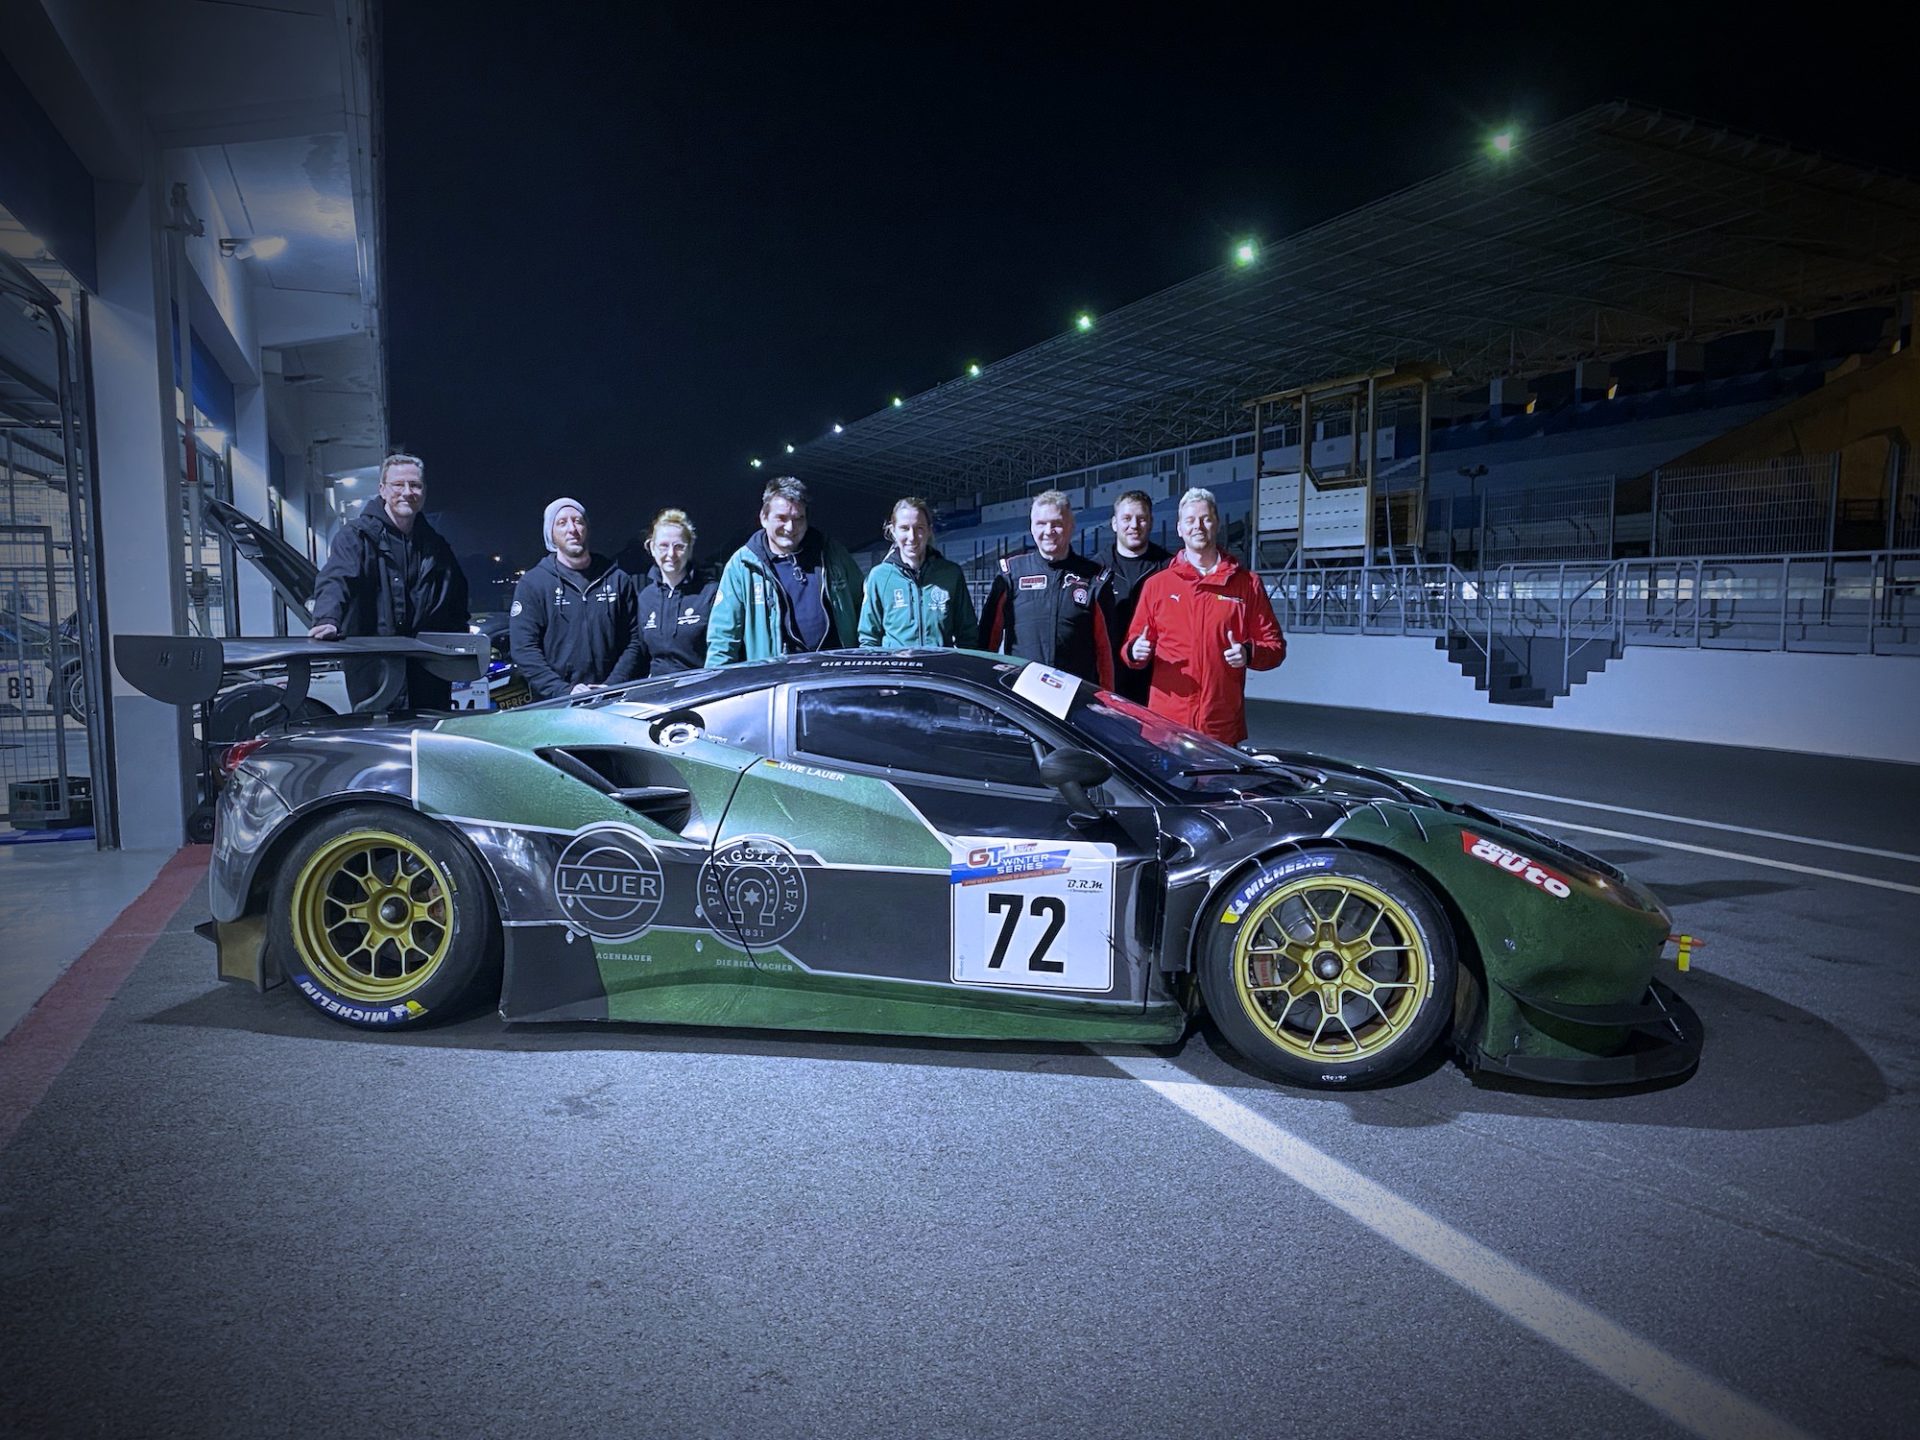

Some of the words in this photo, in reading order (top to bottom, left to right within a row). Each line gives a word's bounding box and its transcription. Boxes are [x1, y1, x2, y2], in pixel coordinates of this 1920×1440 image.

[780, 762, 805, 774] UWE
[806, 767, 846, 783] LAUER
[967, 844, 1007, 867] GT
[1003, 853, 1050, 866] WINTER
[997, 862, 1044, 875] SERIES
[1243, 857, 1328, 900] MICHELIN
[1471, 844, 1571, 898] auto
[561, 871, 658, 897] LAUER
[740, 928, 765, 938] 1831
[988, 893, 1066, 974] 72
[300, 981, 389, 1022] MICHELIN
